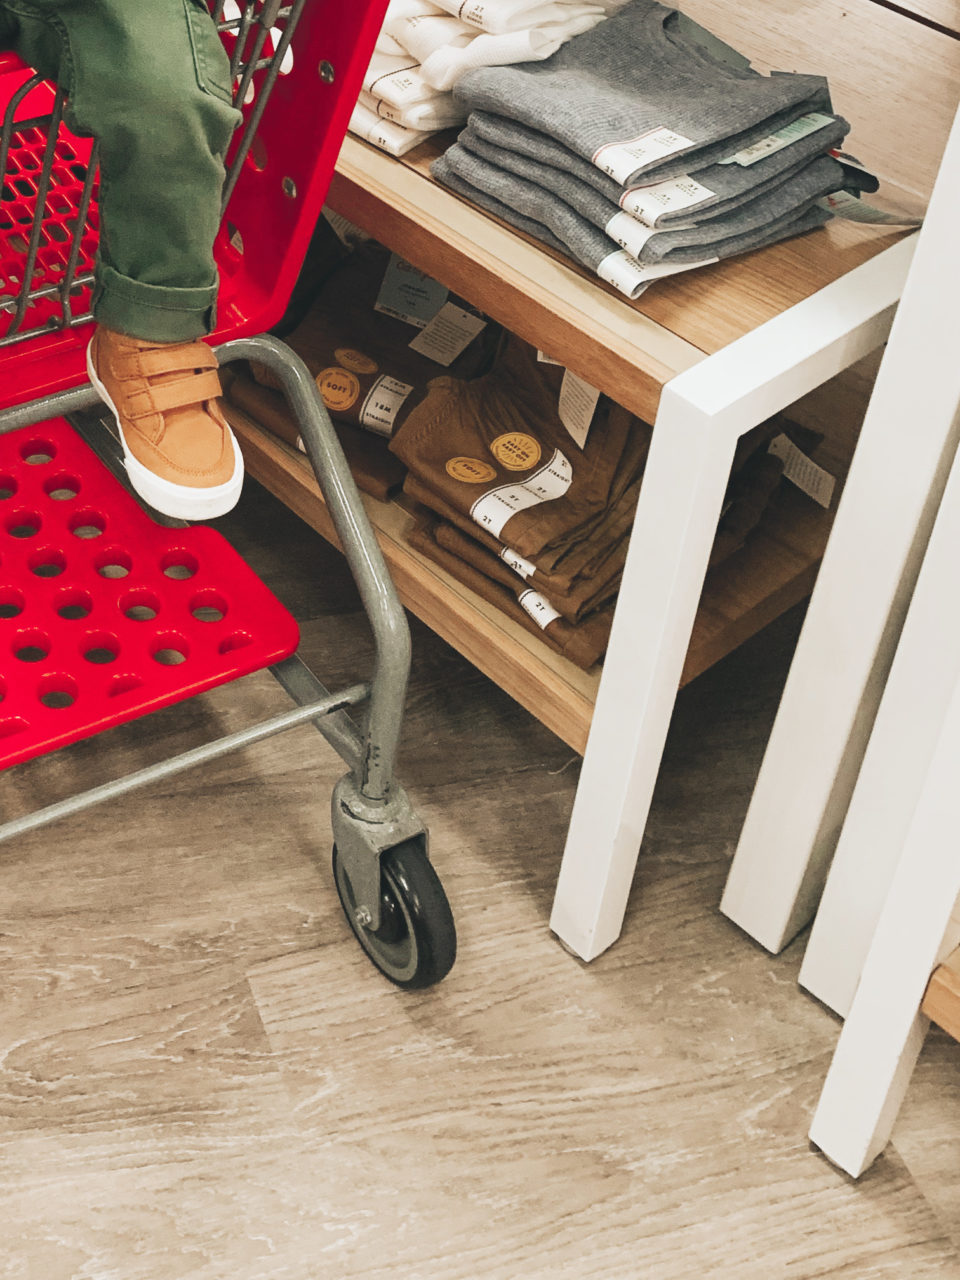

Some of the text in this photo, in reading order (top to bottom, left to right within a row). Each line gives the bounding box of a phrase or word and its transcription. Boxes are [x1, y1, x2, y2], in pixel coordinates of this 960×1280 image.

[327, 381, 347, 393] SOFT
[463, 463, 481, 476] SOFT
[482, 515, 492, 525] 2T
[535, 601, 546, 612] 2T
